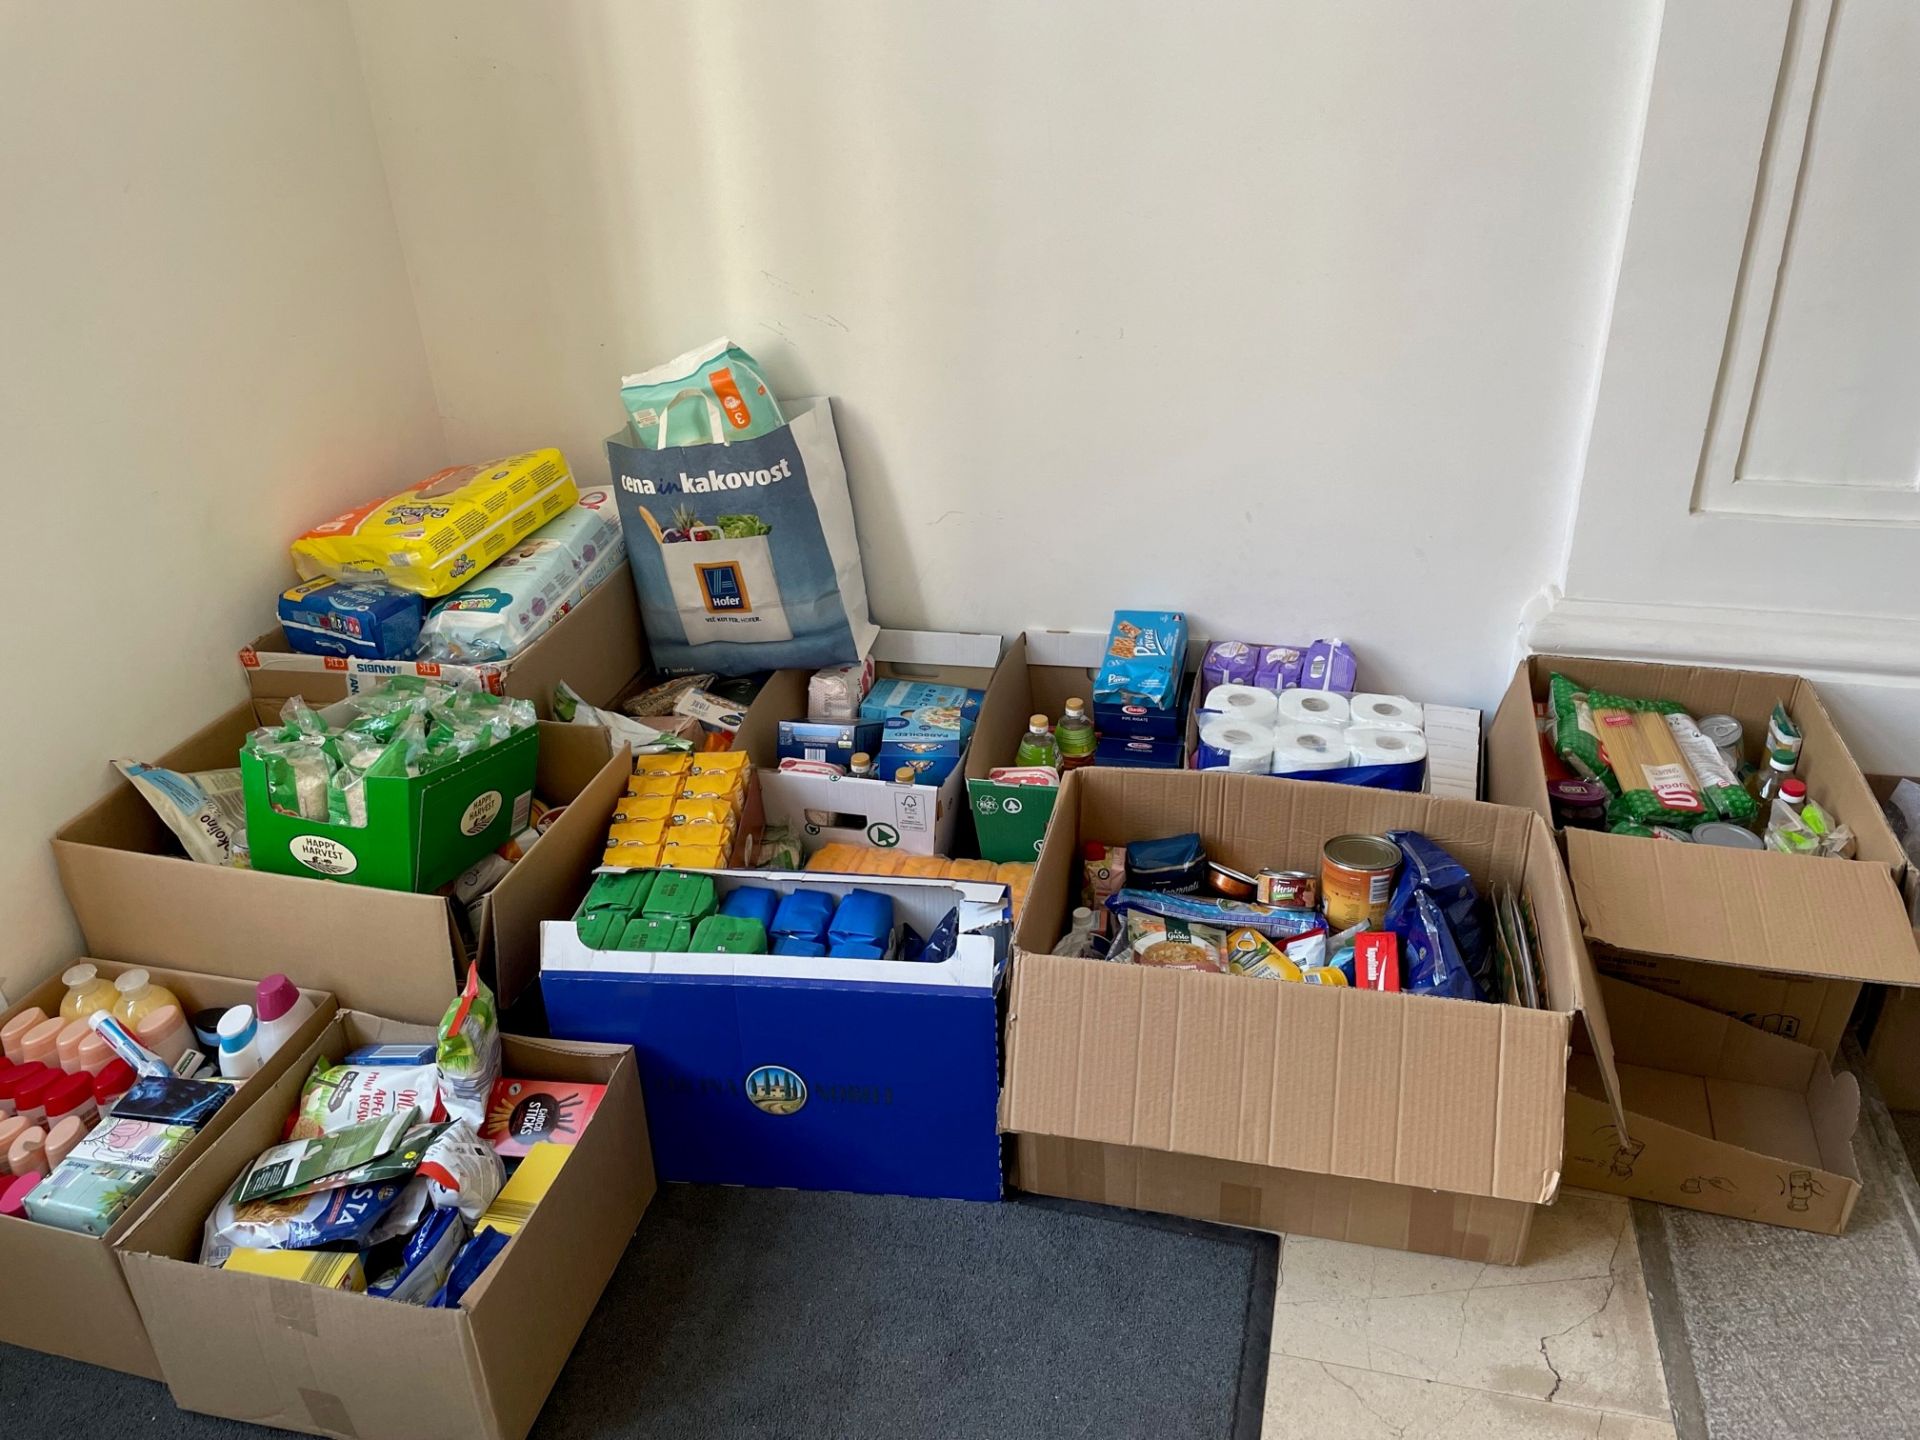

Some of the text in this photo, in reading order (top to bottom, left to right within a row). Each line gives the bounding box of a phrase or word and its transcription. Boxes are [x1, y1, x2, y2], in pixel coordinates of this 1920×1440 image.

[621, 458, 792, 495] cena in kakovost
[712, 596, 740, 606] Hofer
[356, 663, 396, 674] ANUBIS
[473, 794, 492, 808] HAPPY
[200, 814, 232, 862] kolino
[306, 837, 336, 850] HAPPY
[302, 845, 343, 860] HARVEST
[363, 1072, 380, 1091] MINI
[519, 1101, 539, 1136] STICKS
[533, 1107, 547, 1133] CHOCO
[335, 1187, 374, 1226] STA
